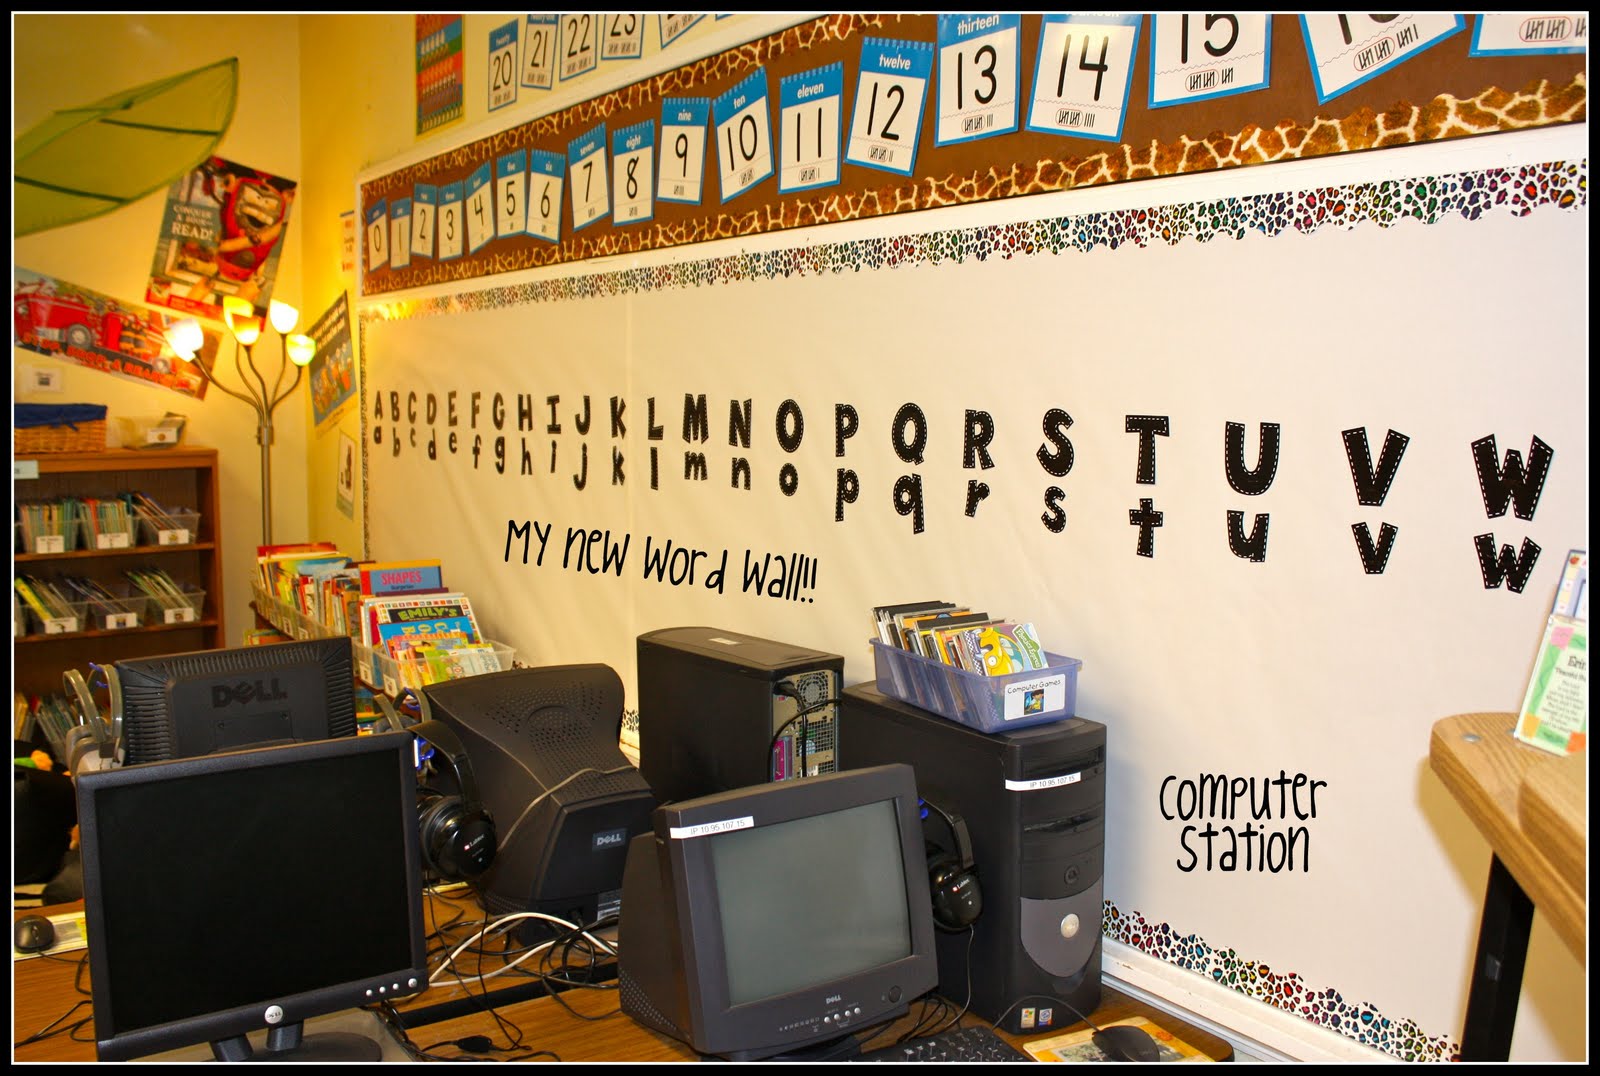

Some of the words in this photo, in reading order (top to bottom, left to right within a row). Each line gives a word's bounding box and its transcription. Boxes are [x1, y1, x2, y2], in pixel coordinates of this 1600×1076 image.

[567, 18, 591, 58] 22
[957, 15, 1000, 36] thirteen
[1180, 14, 1240, 65] 15
[530, 29, 548, 68] 21
[878, 54, 911, 70] twelve
[492, 50, 513, 92] 20
[957, 44, 997, 110] 13
[1056, 33, 1109, 102] 14
[733, 95, 746, 110] ten
[797, 81, 825, 99] eleven
[678, 110, 692, 121] nine
[866, 81, 905, 142] 12
[580, 141, 595, 157] seven
[626, 135, 641, 150] eight
[727, 113, 758, 172] 10
[796, 106, 823, 163] 11
[674, 132, 689, 178] 9
[582, 160, 594, 203] 7
[626, 155, 640, 200] 8
[473, 194, 484, 227] 4
[506, 180, 516, 217] 5
[540, 181, 551, 219] 6
[172, 221, 214, 241] READ!
[419, 208, 427, 240] 2
[446, 208, 455, 241] 3
[374, 390, 384, 420] A
[390, 391, 400, 422] B
[407, 391, 417, 424] C
[426, 392, 438, 426] D
[447, 390, 459, 428] E
[470, 391, 482, 429] F
[492, 392, 506, 431] G
[517, 393, 534, 433] H
[546, 394, 562, 435] I
[574, 395, 592, 437] J
[610, 396, 626, 439] K
[647, 397, 664, 440] L
[683, 394, 709, 444] M
[729, 398, 752, 448] N
[776, 399, 804, 453] O
[835, 403, 859, 457] P
[892, 403, 928, 465] Q
[963, 409, 995, 470] R
[1036, 408, 1074, 477] S
[1125, 415, 1169, 484] T
[1225, 421, 1280, 496] U
[1342, 427, 1410, 506] V
[1471, 434, 1554, 521] W
[373, 425, 383, 446] a
[392, 427, 402, 458] b
[427, 428, 437, 462] d
[447, 431, 458, 455] e
[471, 434, 482, 470] f
[494, 435, 507, 476] g
[520, 437, 533, 477] h
[549, 439, 558, 474] i
[572, 441, 589, 492] j
[684, 450, 708, 481] m
[731, 457, 751, 490] n
[835, 468, 860, 522] p
[893, 473, 925, 535] q
[965, 480, 990, 518] r
[1129, 498, 1163, 558] t
[1227, 509, 1270, 562] u
[381, 570, 422, 586] SHAPES
[211, 678, 288, 708] DELL
[1007, 683, 1039, 694] Computer
[1038, 679, 1062, 688] Games
[596, 833, 622, 846] DELL
[826, 995, 842, 1004] DELL
